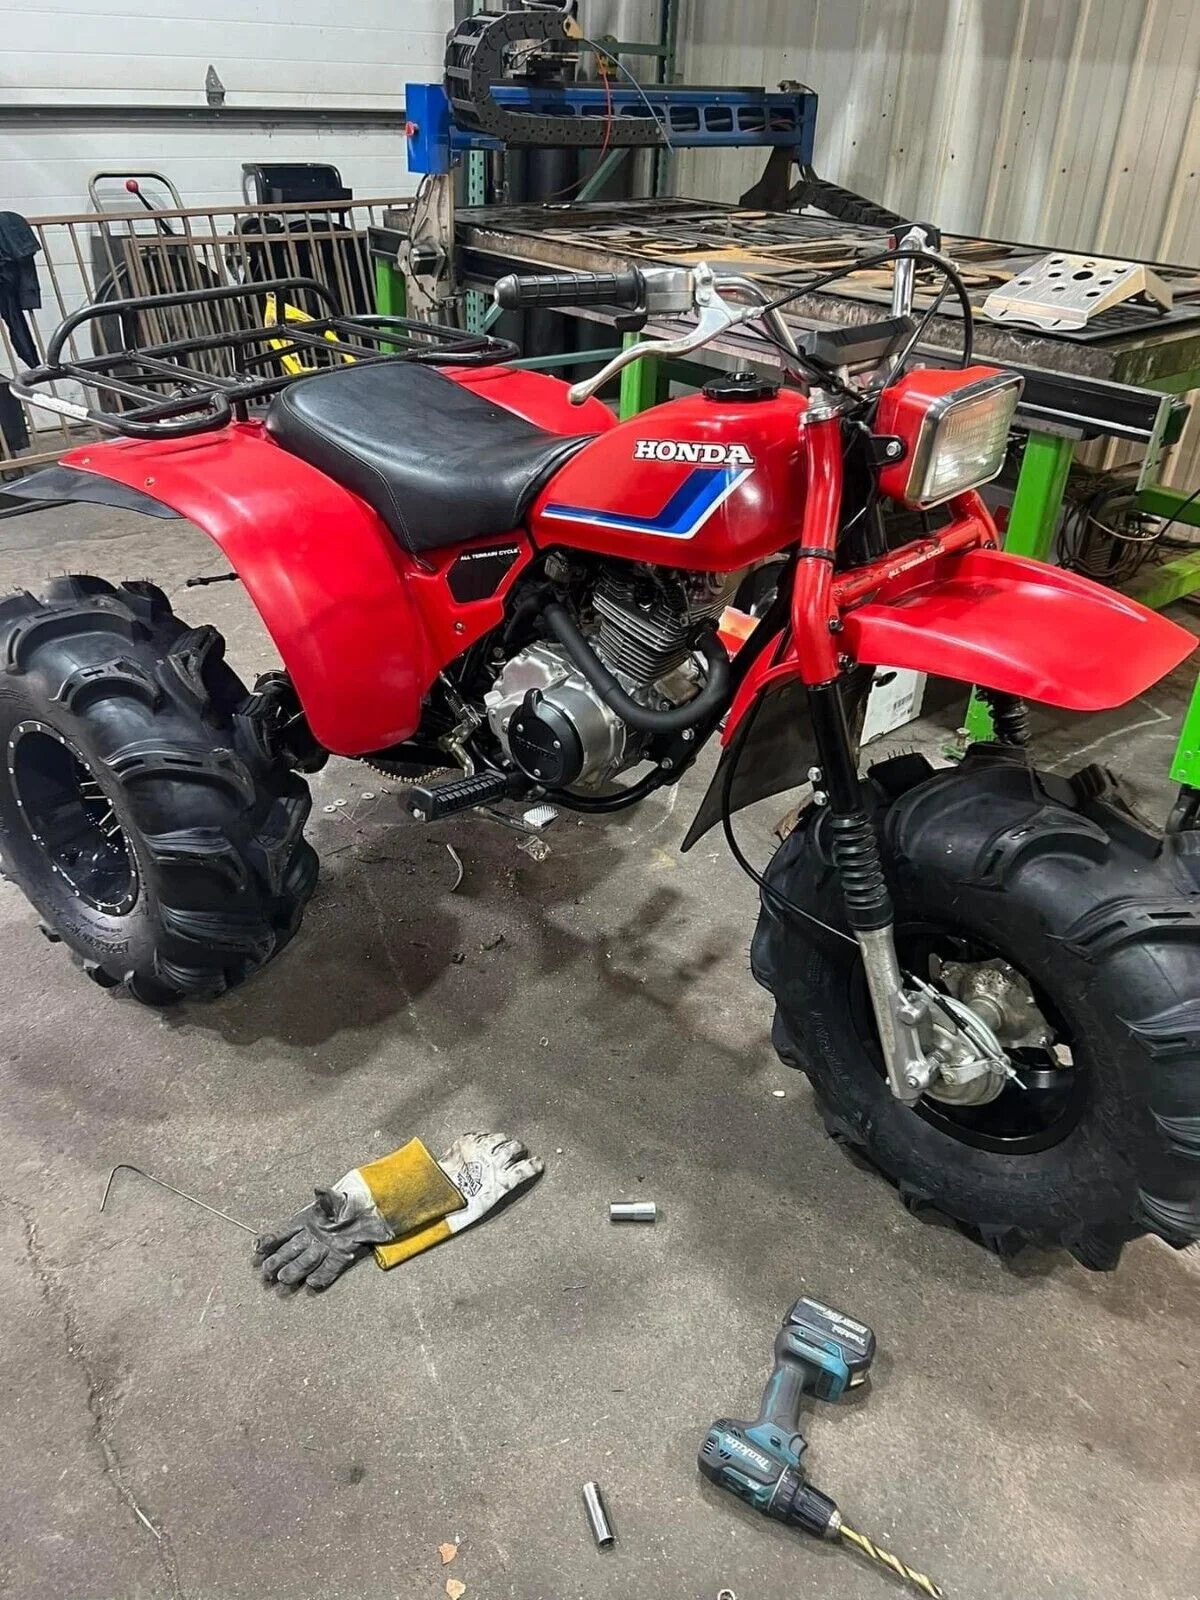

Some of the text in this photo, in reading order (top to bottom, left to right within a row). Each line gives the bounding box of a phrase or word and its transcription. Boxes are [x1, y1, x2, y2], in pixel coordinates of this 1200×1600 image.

[633, 440, 755, 465] HONDA
[472, 551, 498, 559] TERRAIN
[498, 548, 518, 556] CYCLE
